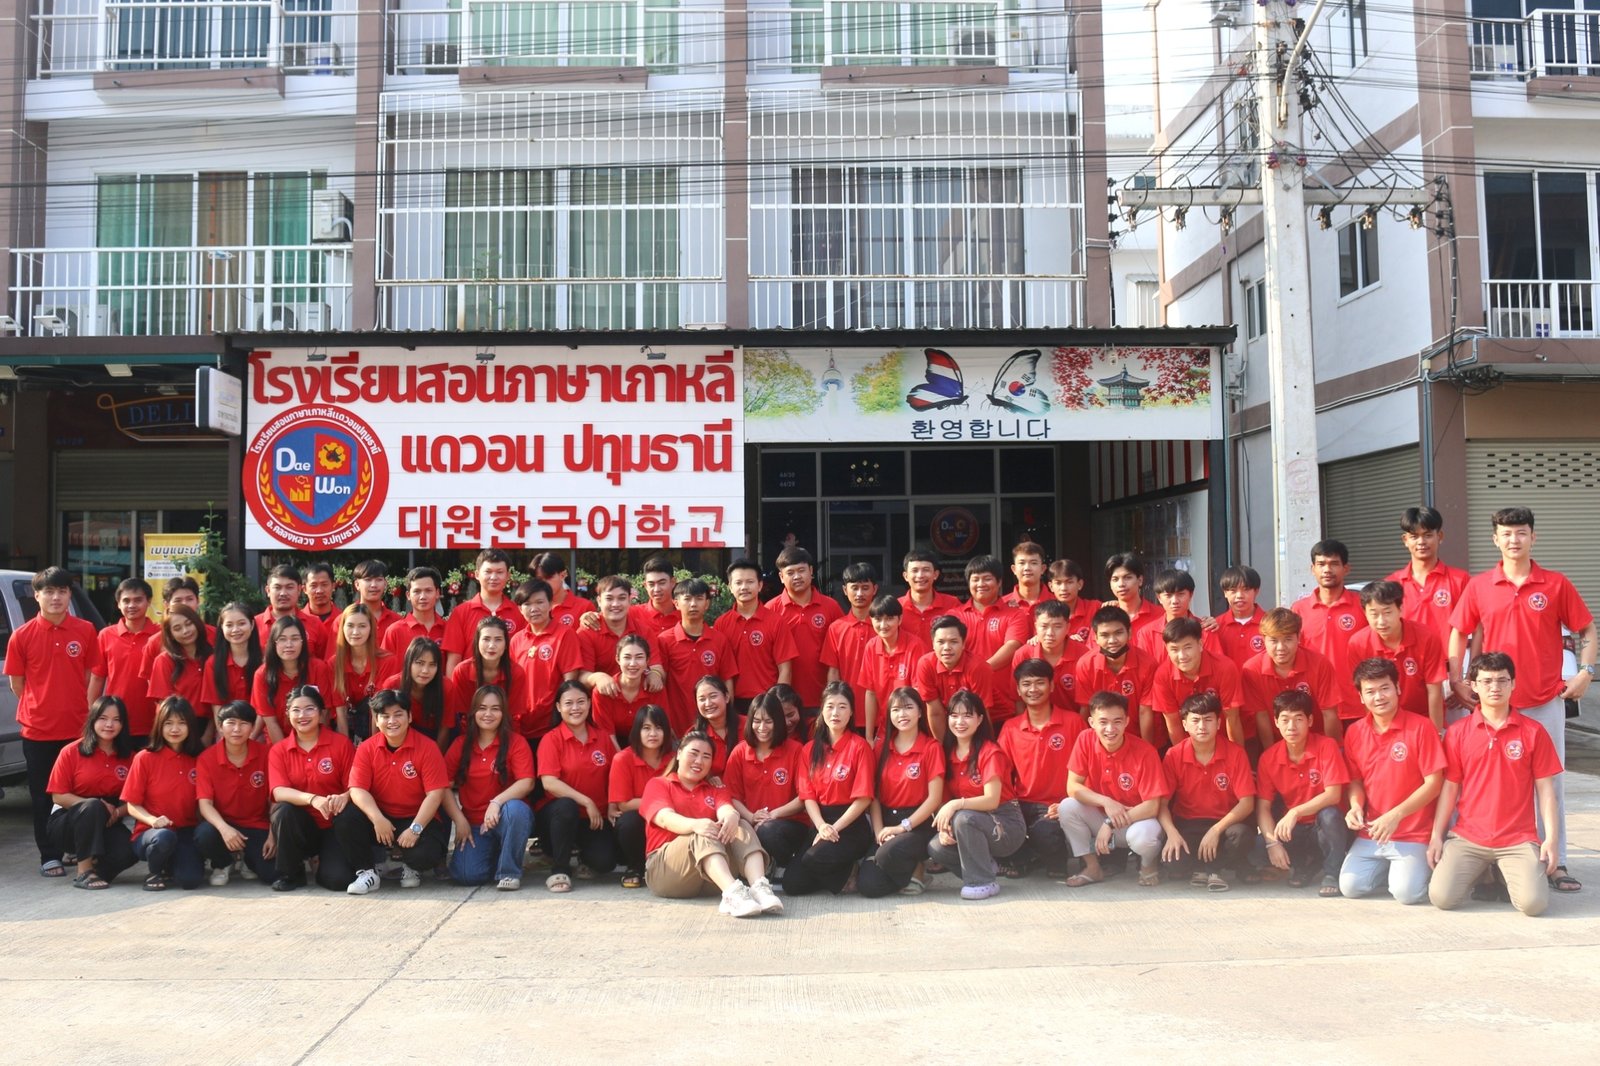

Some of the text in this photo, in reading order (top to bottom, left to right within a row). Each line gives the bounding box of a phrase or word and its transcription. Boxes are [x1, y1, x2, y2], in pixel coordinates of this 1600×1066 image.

[248, 351, 735, 404] โรงเรียนสอนภาษาเกาหลี
[911, 418, 1051, 440] 환영합니다
[276, 447, 311, 472] Dae
[401, 418, 733, 486] แดวอน ปทุมธานี
[315, 476, 351, 495] Won
[399, 504, 726, 549] 대원한국어학교
